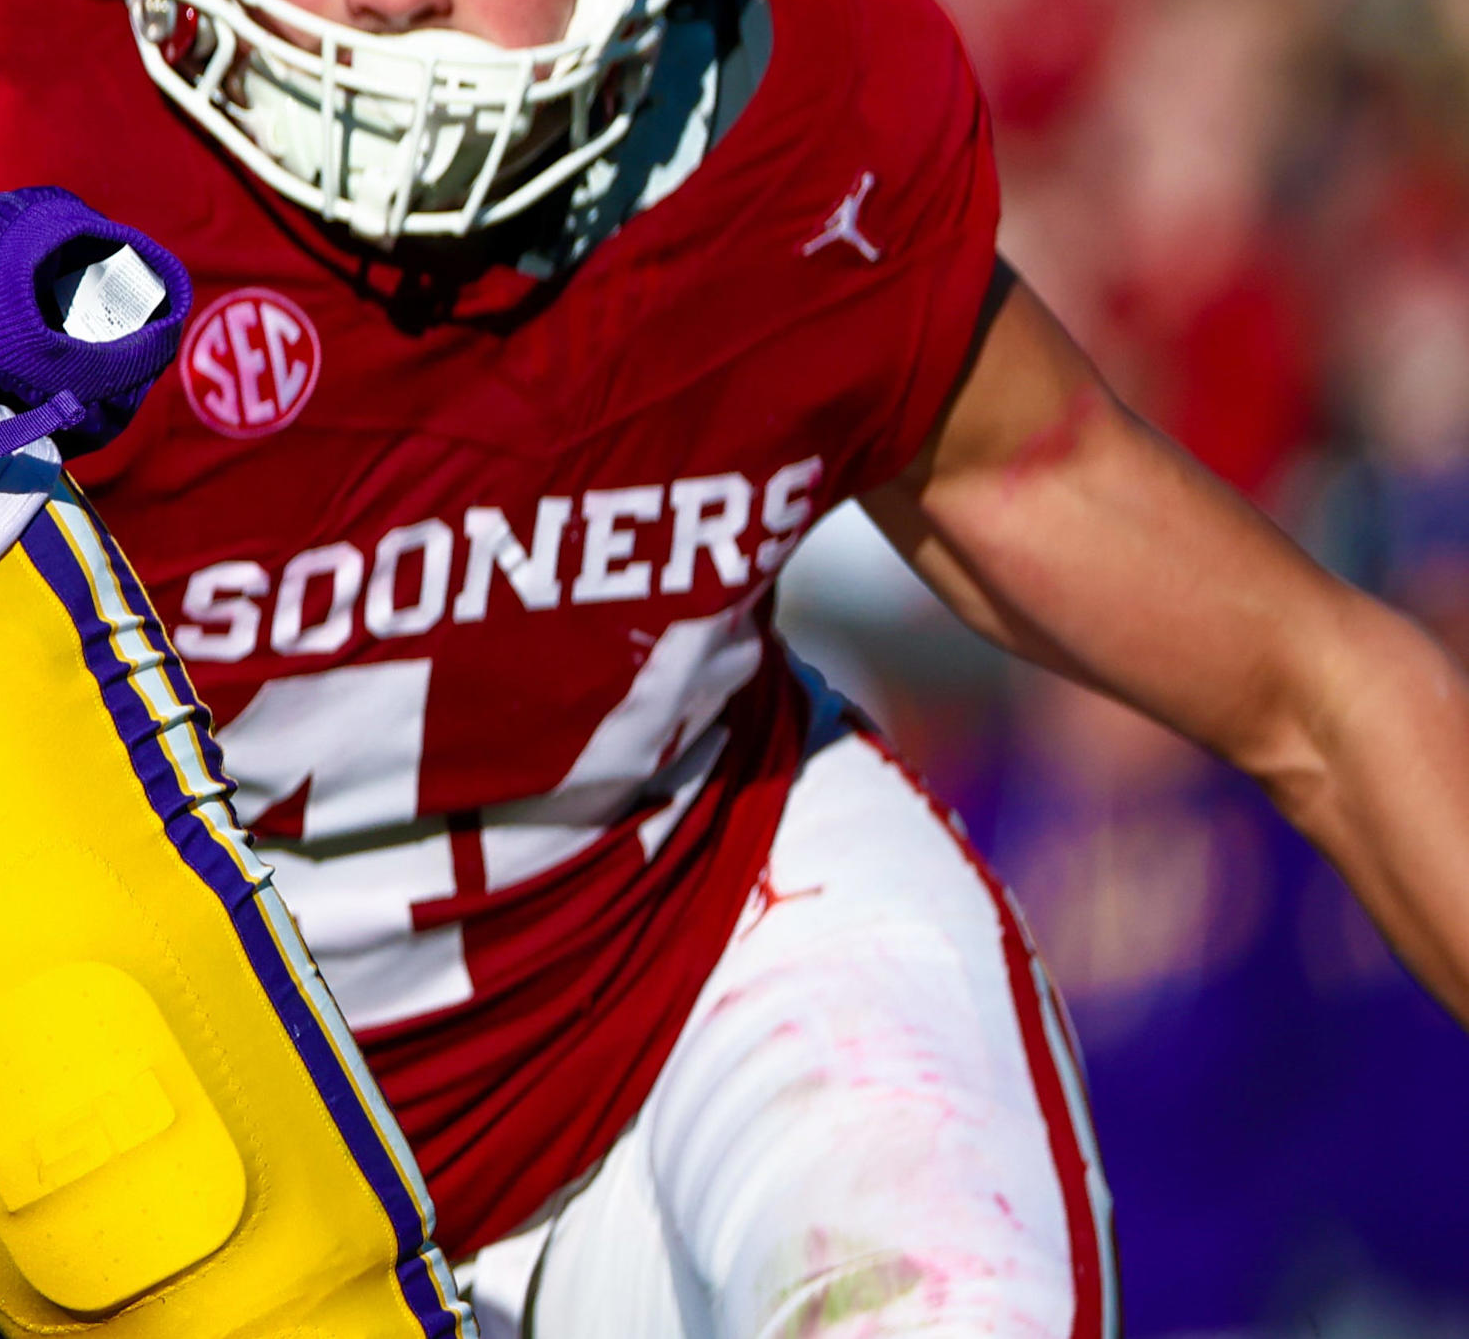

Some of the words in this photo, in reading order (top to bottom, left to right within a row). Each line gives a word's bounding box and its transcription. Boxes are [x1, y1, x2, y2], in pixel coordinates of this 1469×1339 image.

[191, 301, 308, 427] SEC
[173, 454, 824, 662] SOONERS
[215, 606, 764, 1032] 44
